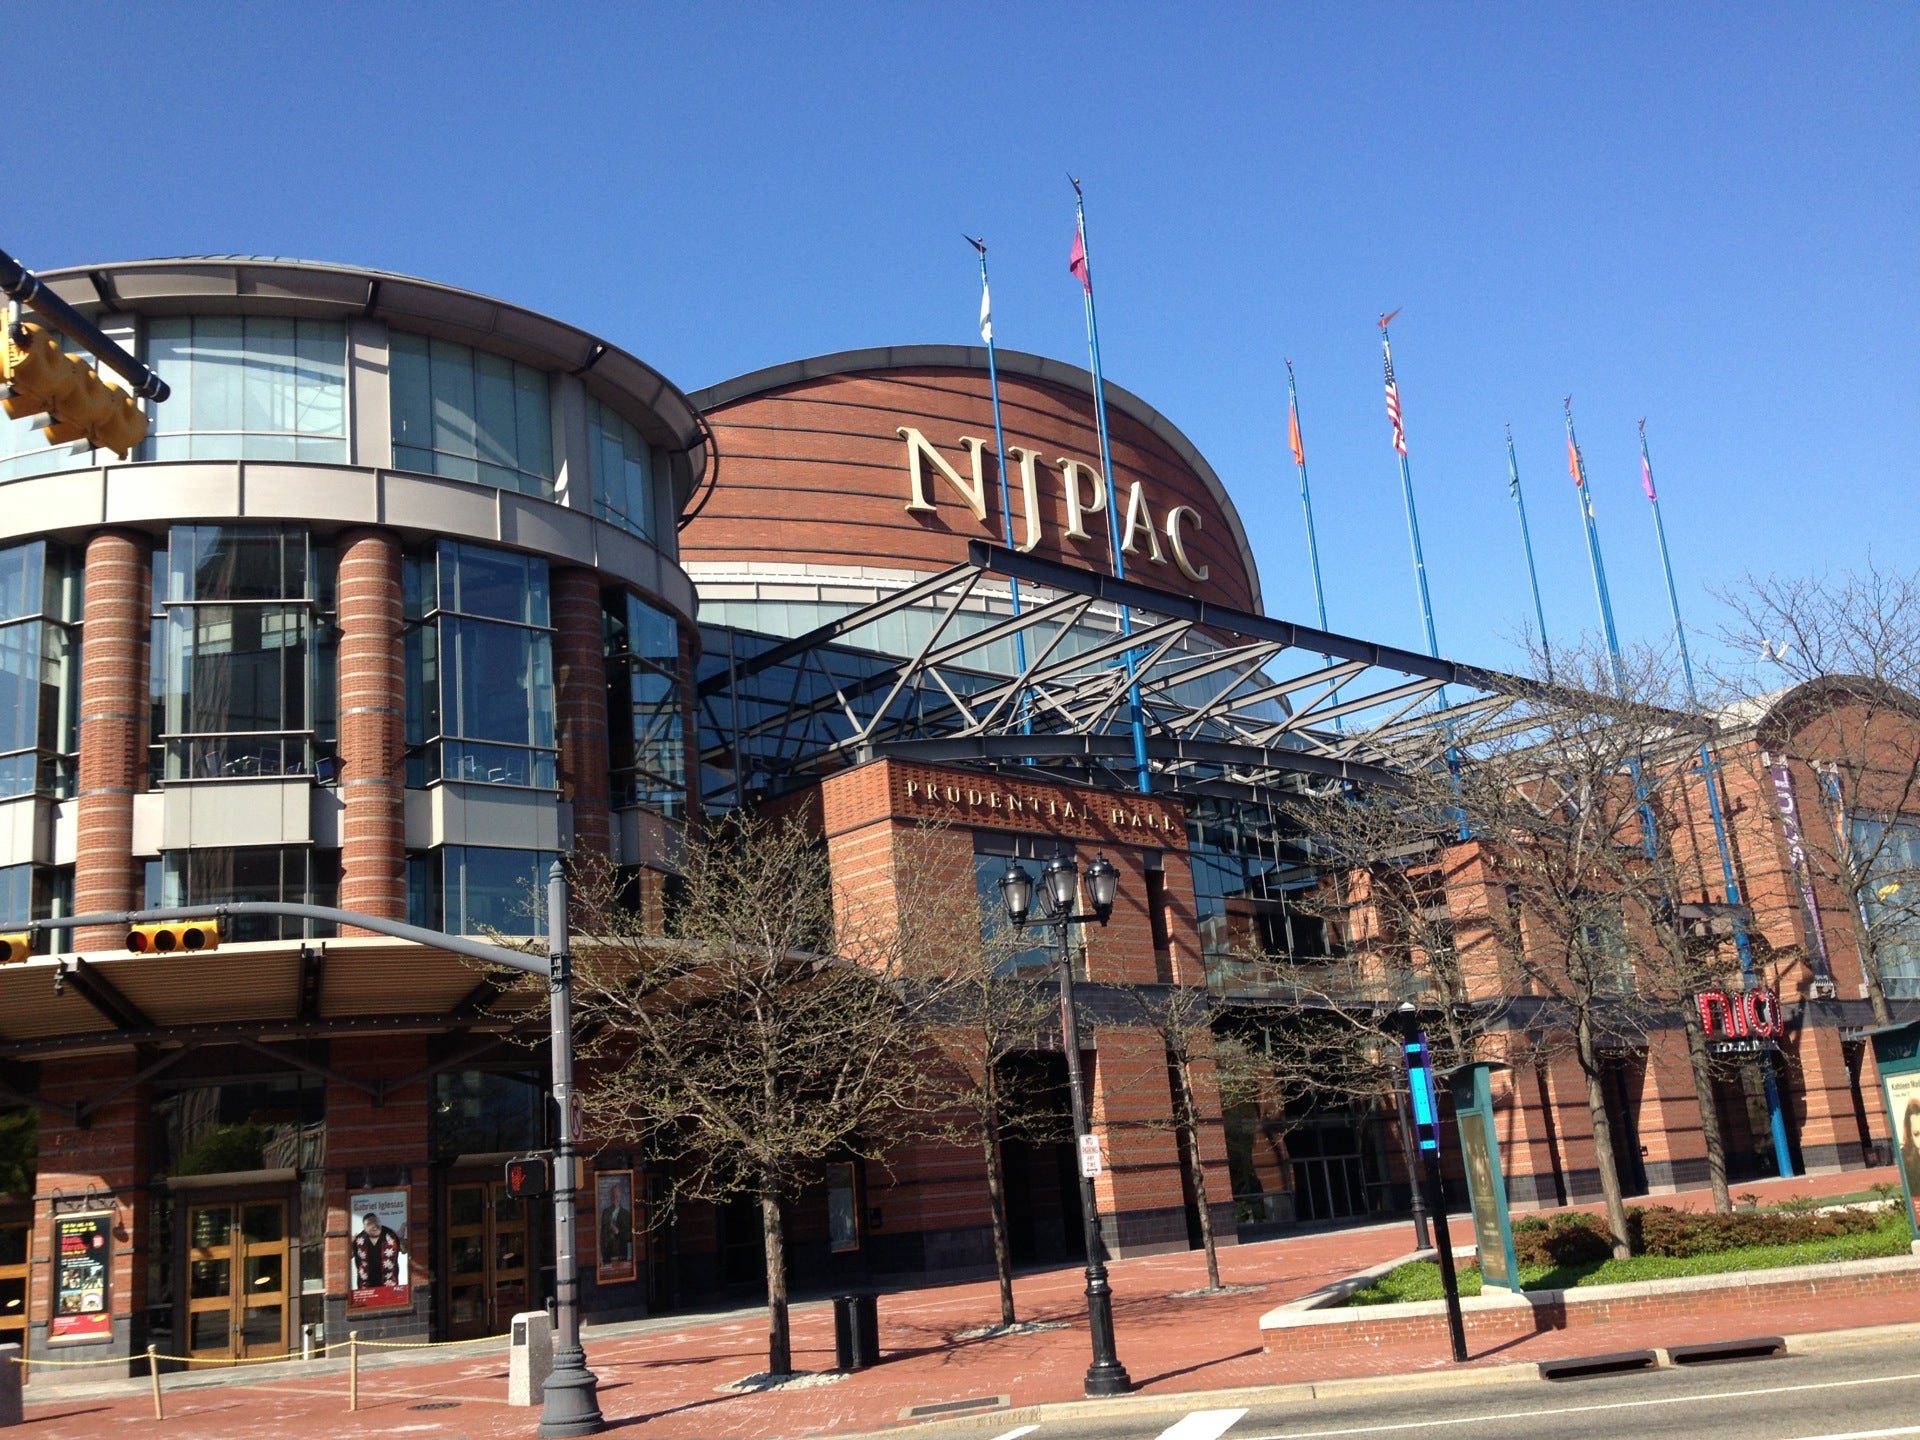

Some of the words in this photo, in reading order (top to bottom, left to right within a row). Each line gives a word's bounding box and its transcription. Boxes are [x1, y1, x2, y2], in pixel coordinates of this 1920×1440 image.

[896, 426, 1209, 582] NJPAC
[907, 779, 1093, 821] PRUDENTIAL
[1111, 807, 1175, 831] HALL
[1085, 1137, 1094, 1146] NO
[353, 1202, 377, 1212] Gabriel
[378, 1200, 404, 1211] Iglesias
